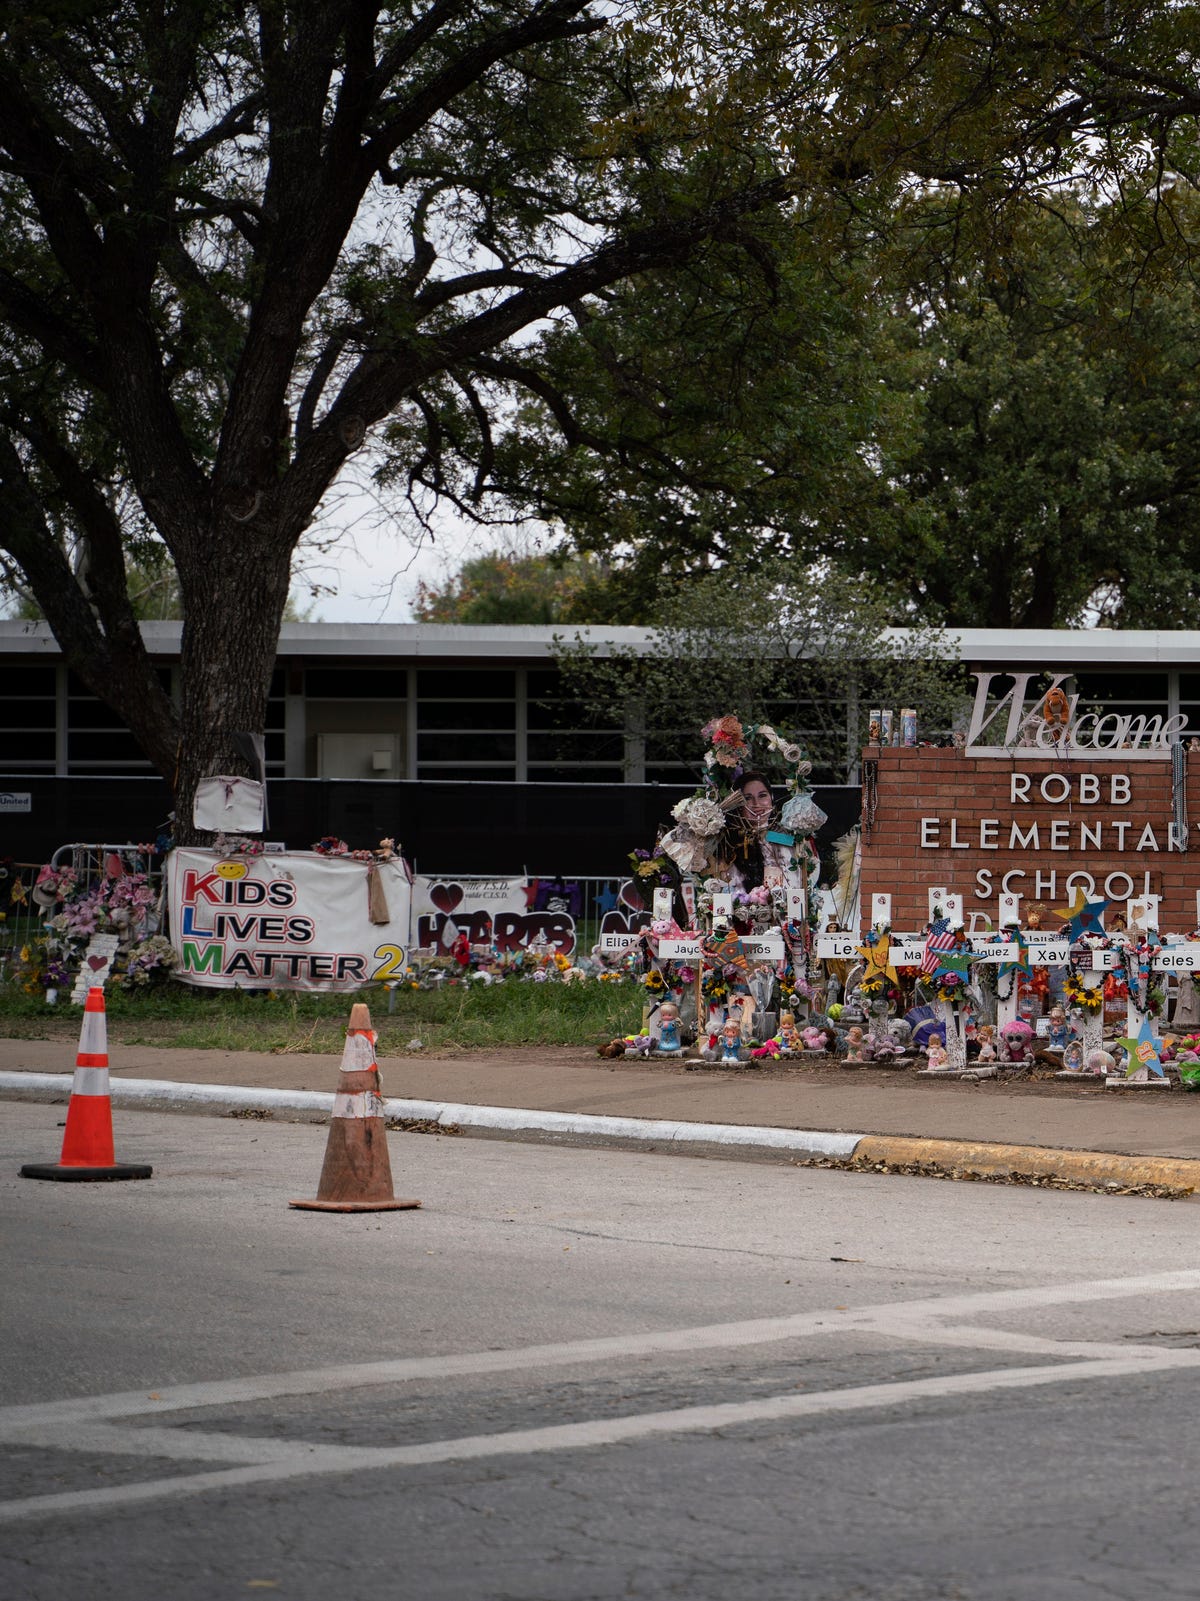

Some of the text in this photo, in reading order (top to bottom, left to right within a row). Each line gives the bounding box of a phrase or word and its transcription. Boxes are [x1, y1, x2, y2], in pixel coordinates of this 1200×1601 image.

[969, 672, 1189, 750] Welcome
[1010, 773, 1132, 805] ROBB
[184, 869, 295, 906] KIDS
[483, 881, 510, 891] I.S.D.
[974, 868, 1164, 903] SCHOOL
[183, 906, 313, 944] LIVES
[183, 942, 405, 981] MATTER 2
